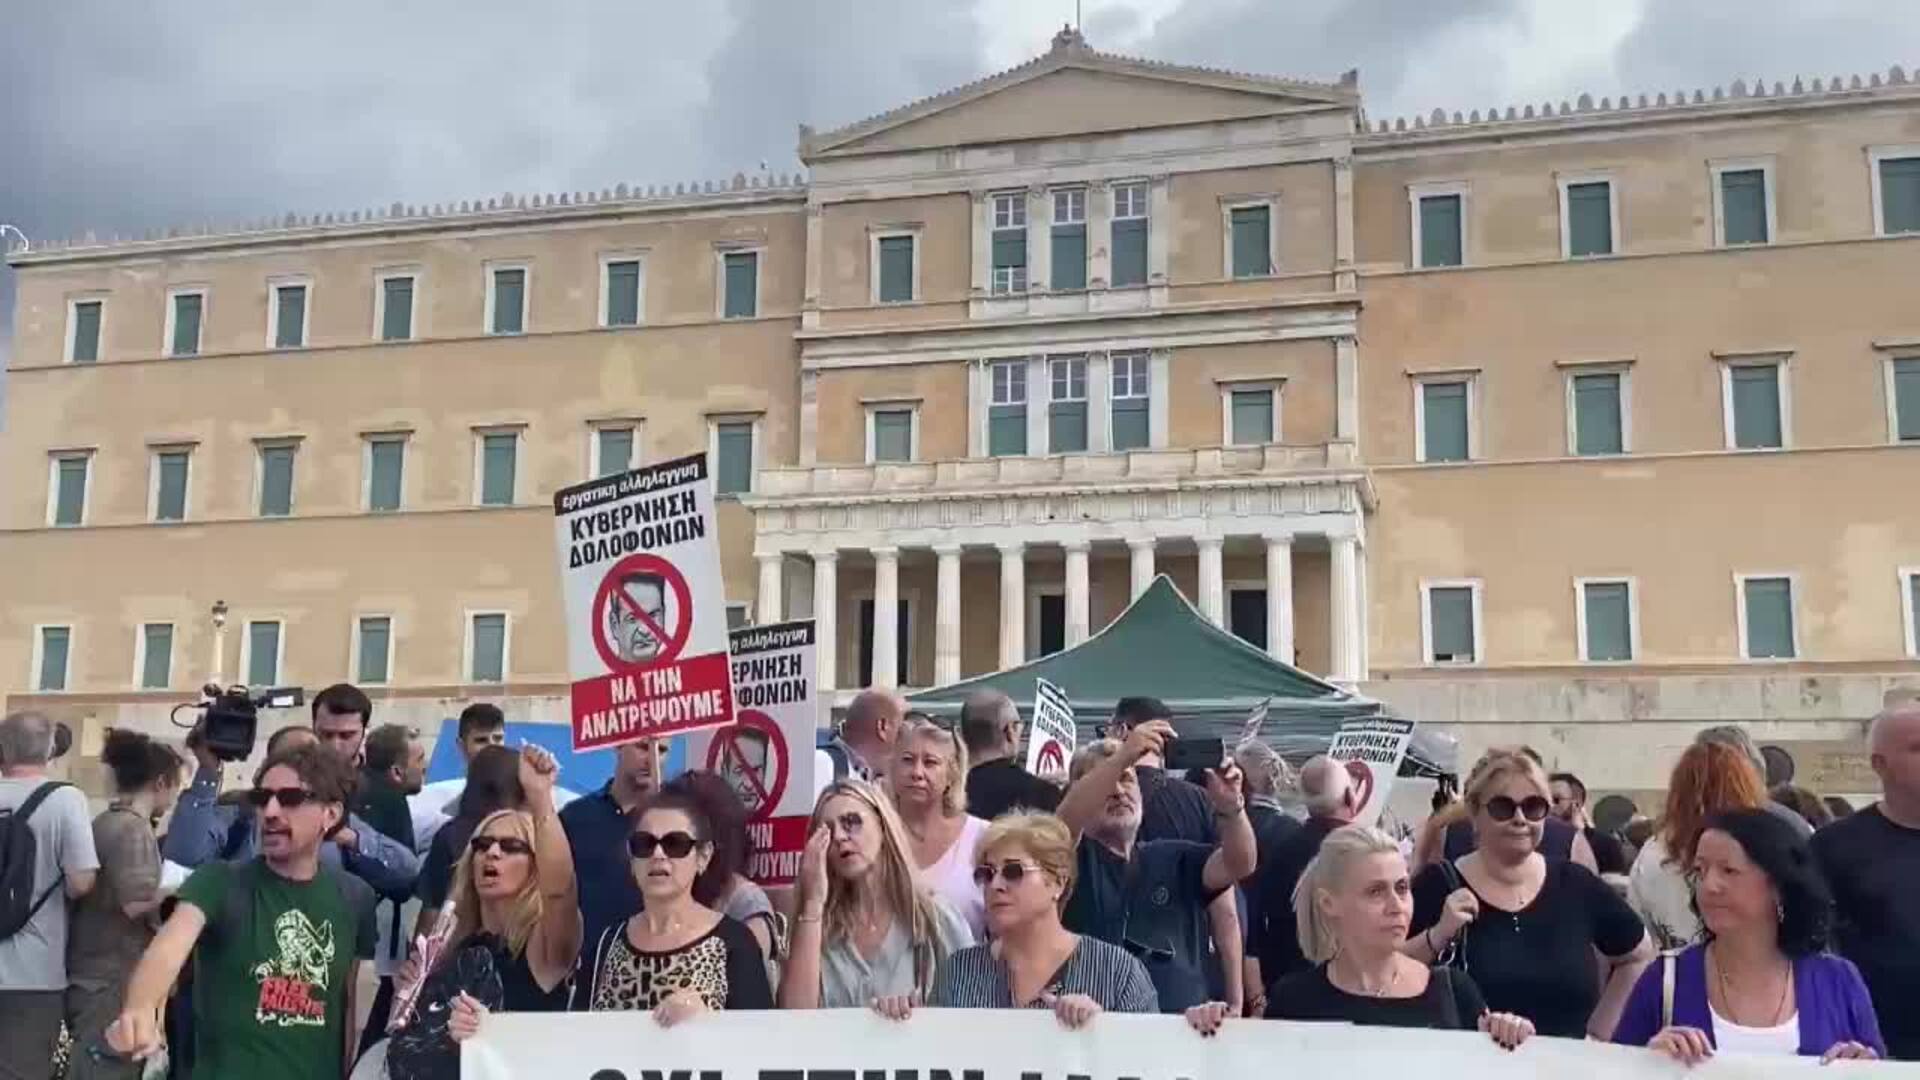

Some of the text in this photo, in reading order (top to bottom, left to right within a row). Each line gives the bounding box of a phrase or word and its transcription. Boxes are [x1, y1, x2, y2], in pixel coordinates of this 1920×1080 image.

[570, 489, 697, 541] ΚΥΒΕΡΝΗΣΗ
[570, 515, 705, 568] ΔΟΛΟΦΟΝΩΝ
[610, 665, 682, 704] ΝΑ ΤΗΝ
[732, 653, 802, 684] ΕΡΝΗΣΗ
[580, 689, 724, 741] ΑΝΑΤΡΕΨΟΥΜΕ
[734, 679, 807, 707] ΦΟΝΩΝ
